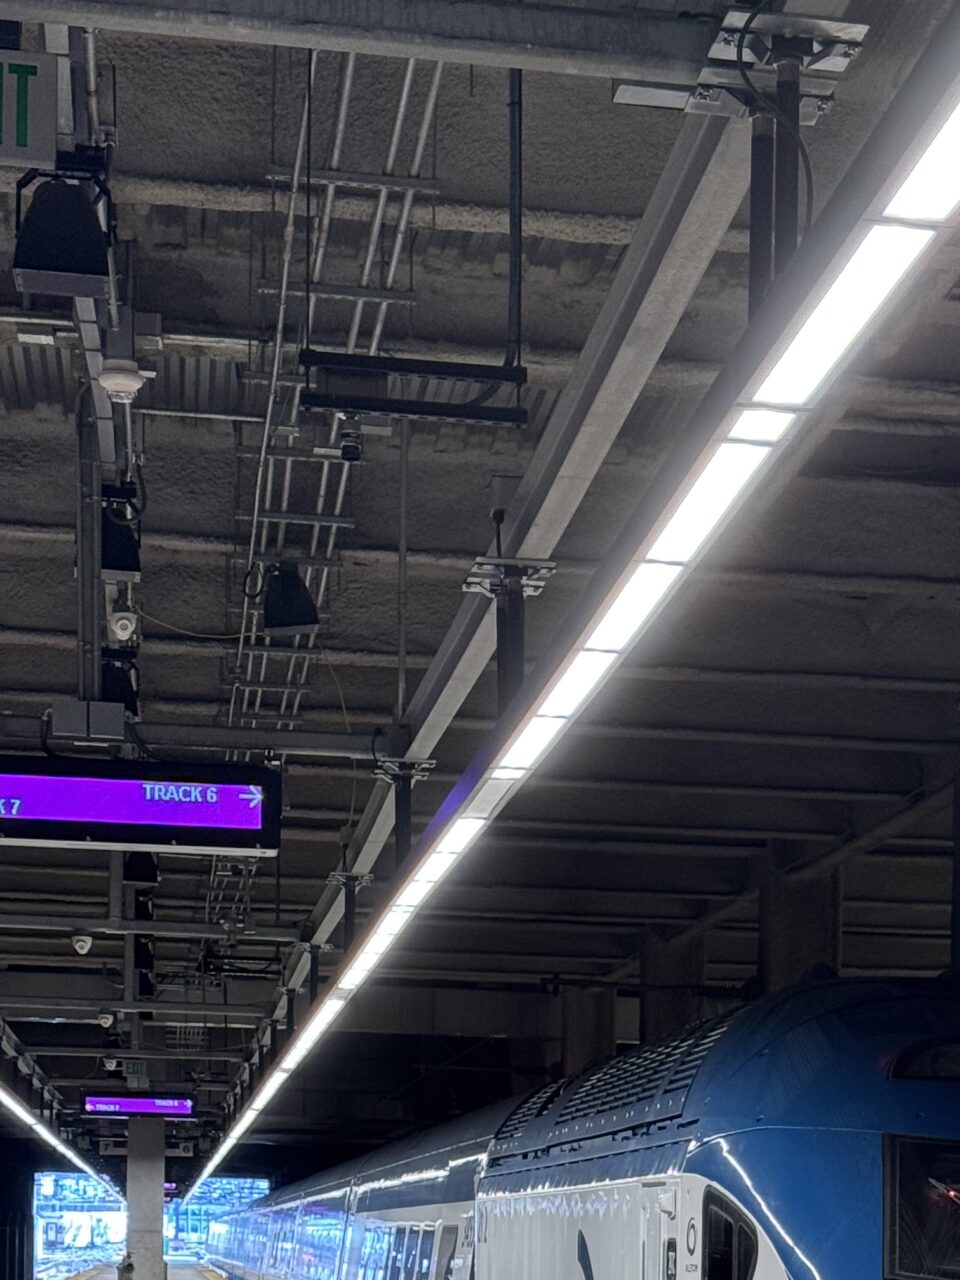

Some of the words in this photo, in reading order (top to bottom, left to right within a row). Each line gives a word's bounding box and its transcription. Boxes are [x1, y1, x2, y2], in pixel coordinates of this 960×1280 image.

[142, 783, 202, 802] TRACK
[206, 786, 217, 803] 6
[10, 799, 21, 815] 7
[103, 1141, 109, 1152] 7
[182, 1143, 190, 1153] 6
